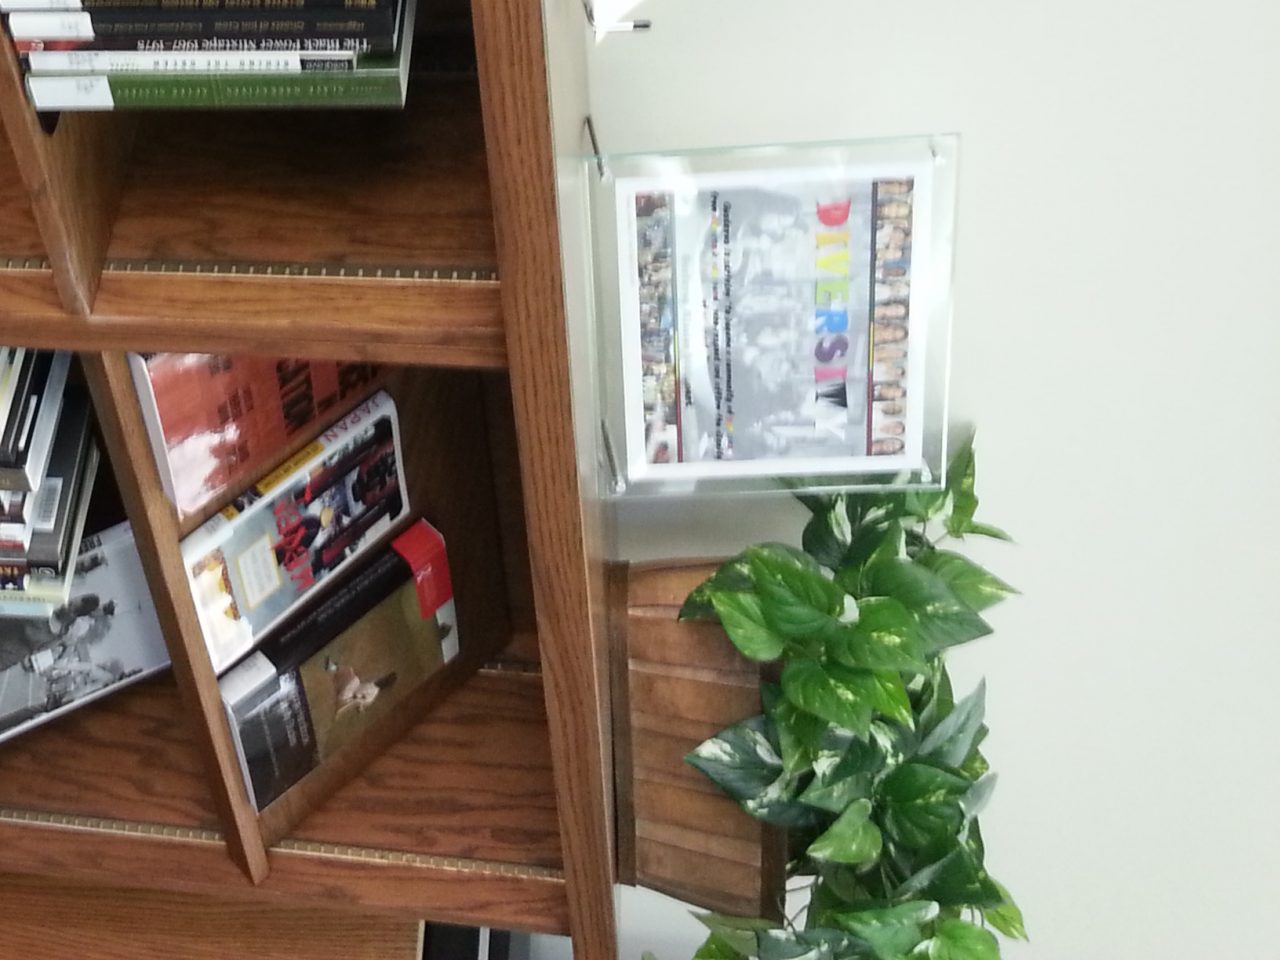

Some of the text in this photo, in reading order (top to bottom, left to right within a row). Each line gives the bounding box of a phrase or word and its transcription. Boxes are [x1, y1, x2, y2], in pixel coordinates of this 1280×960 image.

[201, 36, 371, 53] The Black Power Mixtape
[813, 198, 853, 440] DIVERSITY
[322, 400, 380, 443] JAPAN
